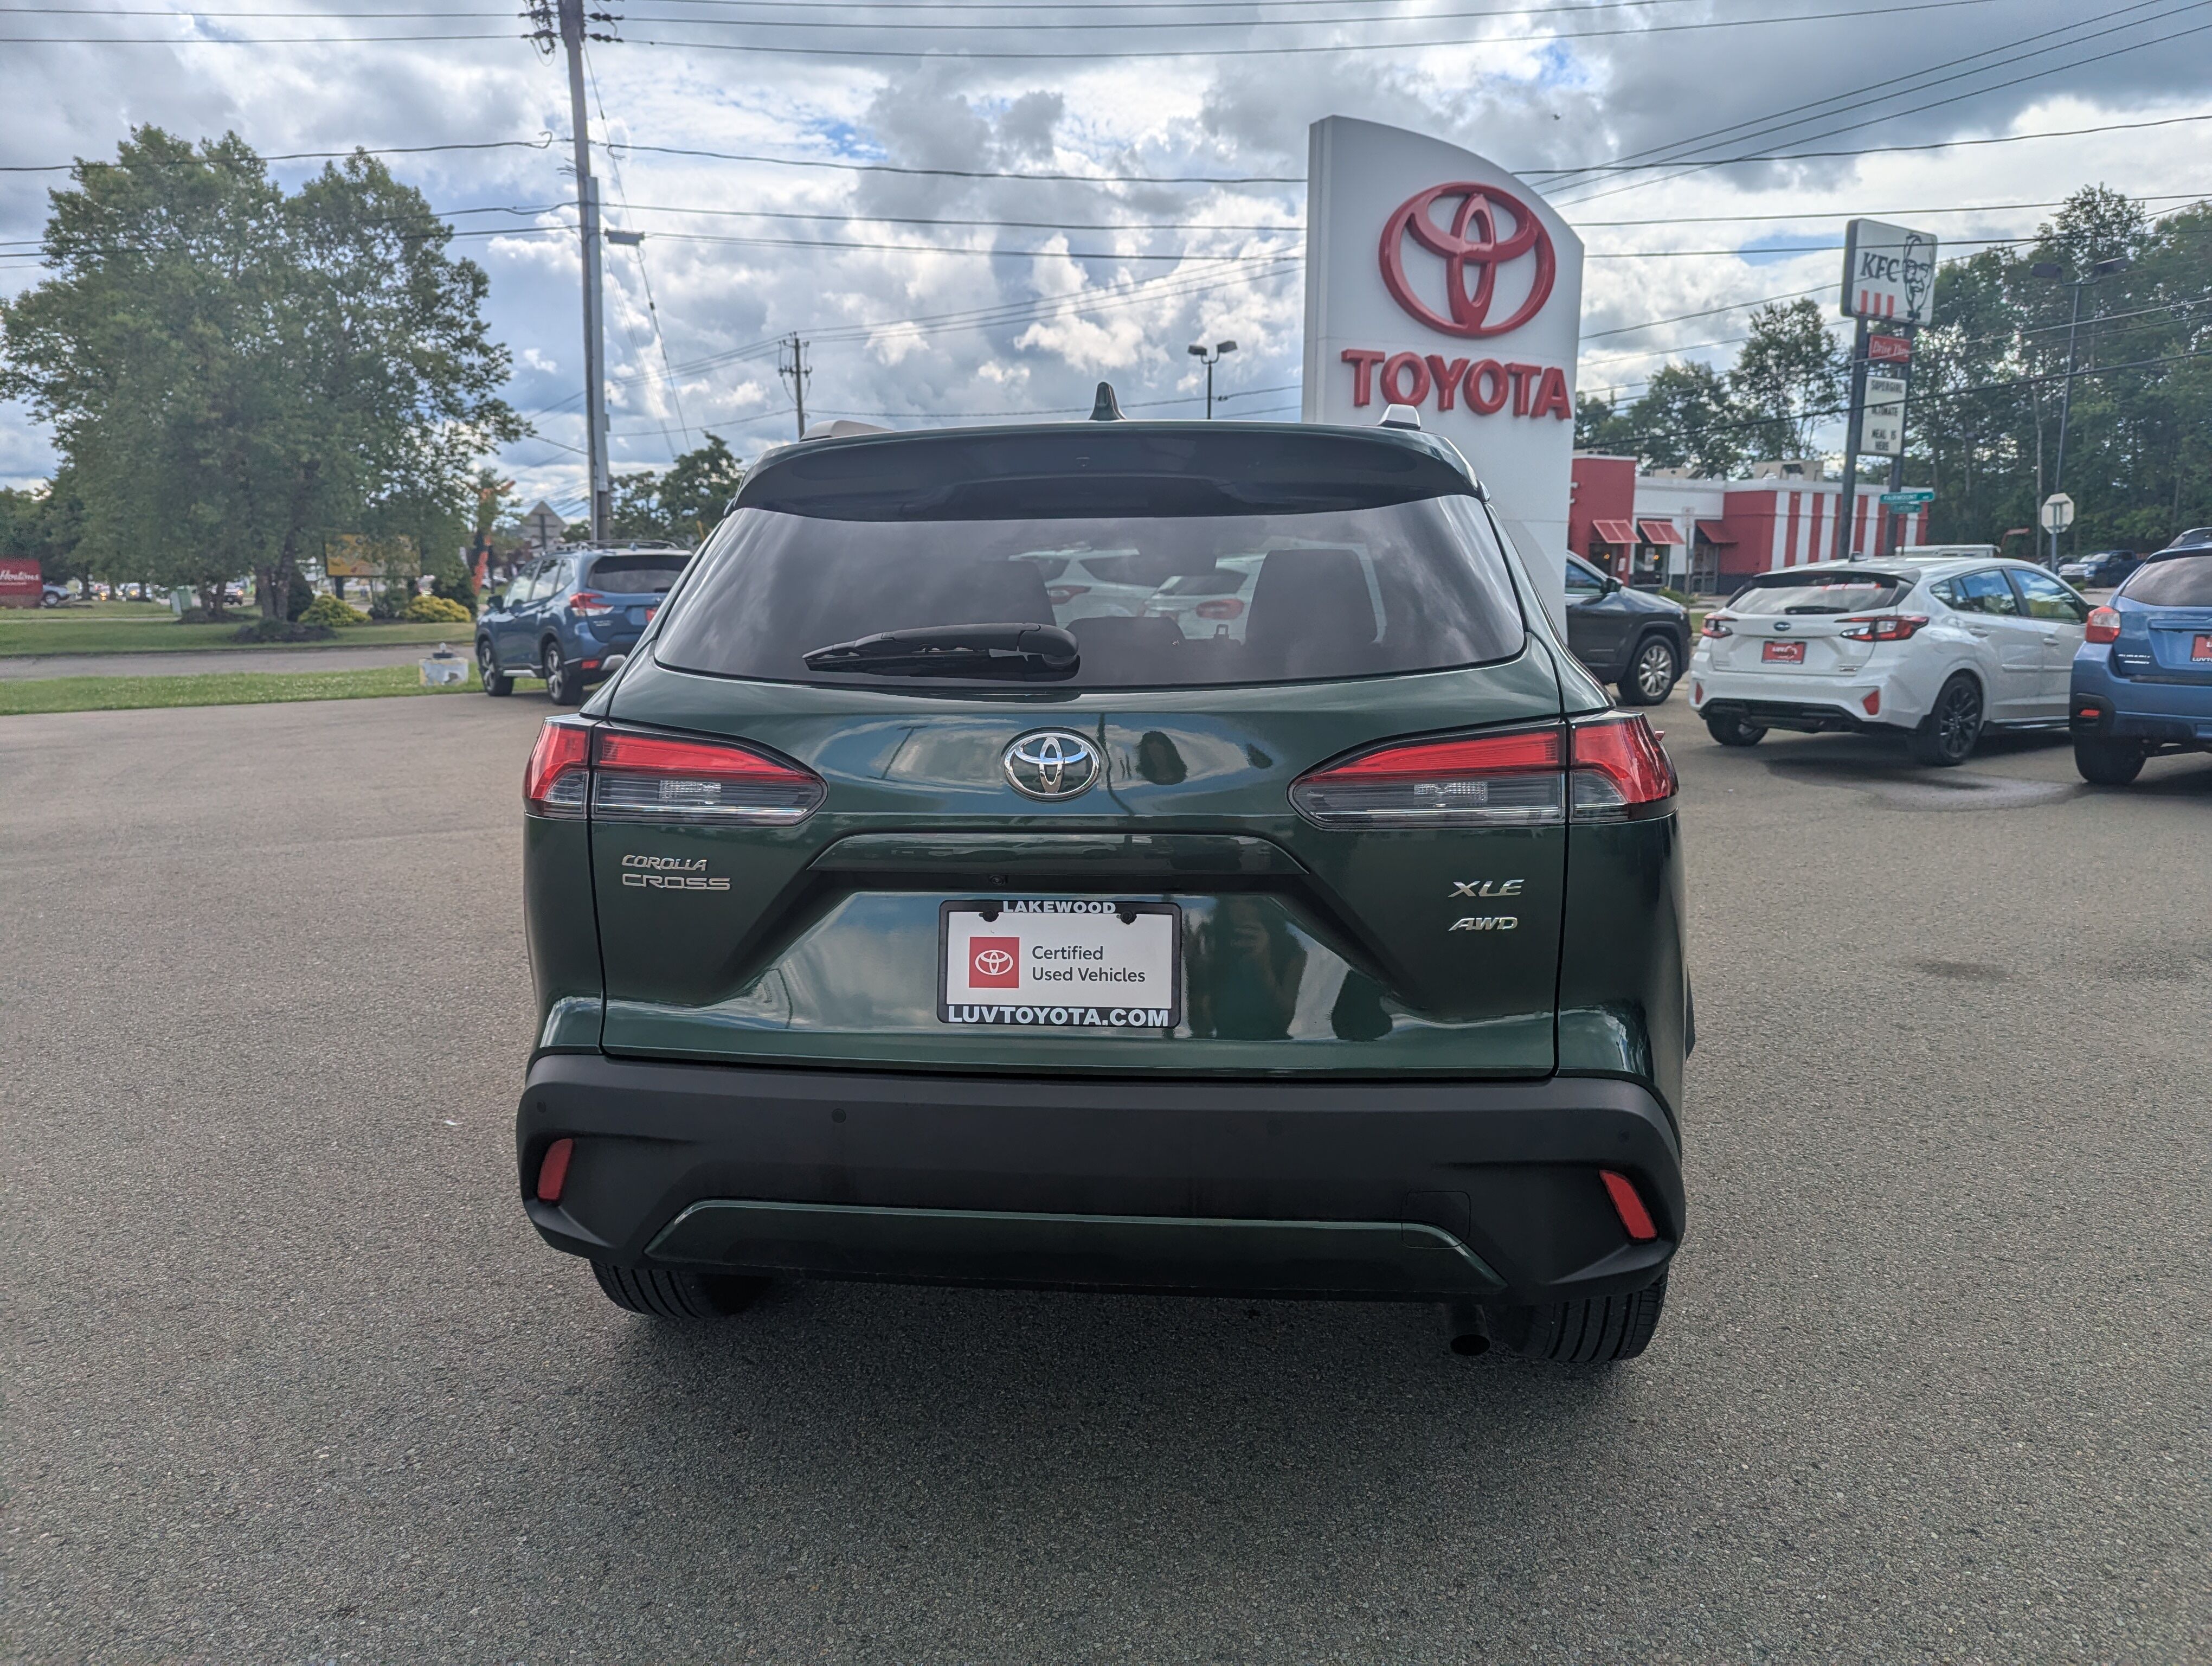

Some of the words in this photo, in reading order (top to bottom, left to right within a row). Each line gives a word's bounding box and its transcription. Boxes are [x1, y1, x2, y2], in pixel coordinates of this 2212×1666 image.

[1860, 252, 1899, 282] KFC
[1341, 349, 1571, 420] TOYOTA
[1872, 429, 1886, 439] MEAL
[622, 855, 708, 871] COROLLA
[622, 873, 731, 890] CROSS
[1448, 879, 1525, 898] XLE
[1002, 900, 1116, 914] LAKEWOOD
[1448, 917, 1518, 932] AWD
[1032, 945, 1103, 960] Certified
[1032, 966, 1073, 981] Used
[1078, 967, 1146, 982] Vehicles
[948, 1005, 1168, 1027] LUVTOYOTA.COM
